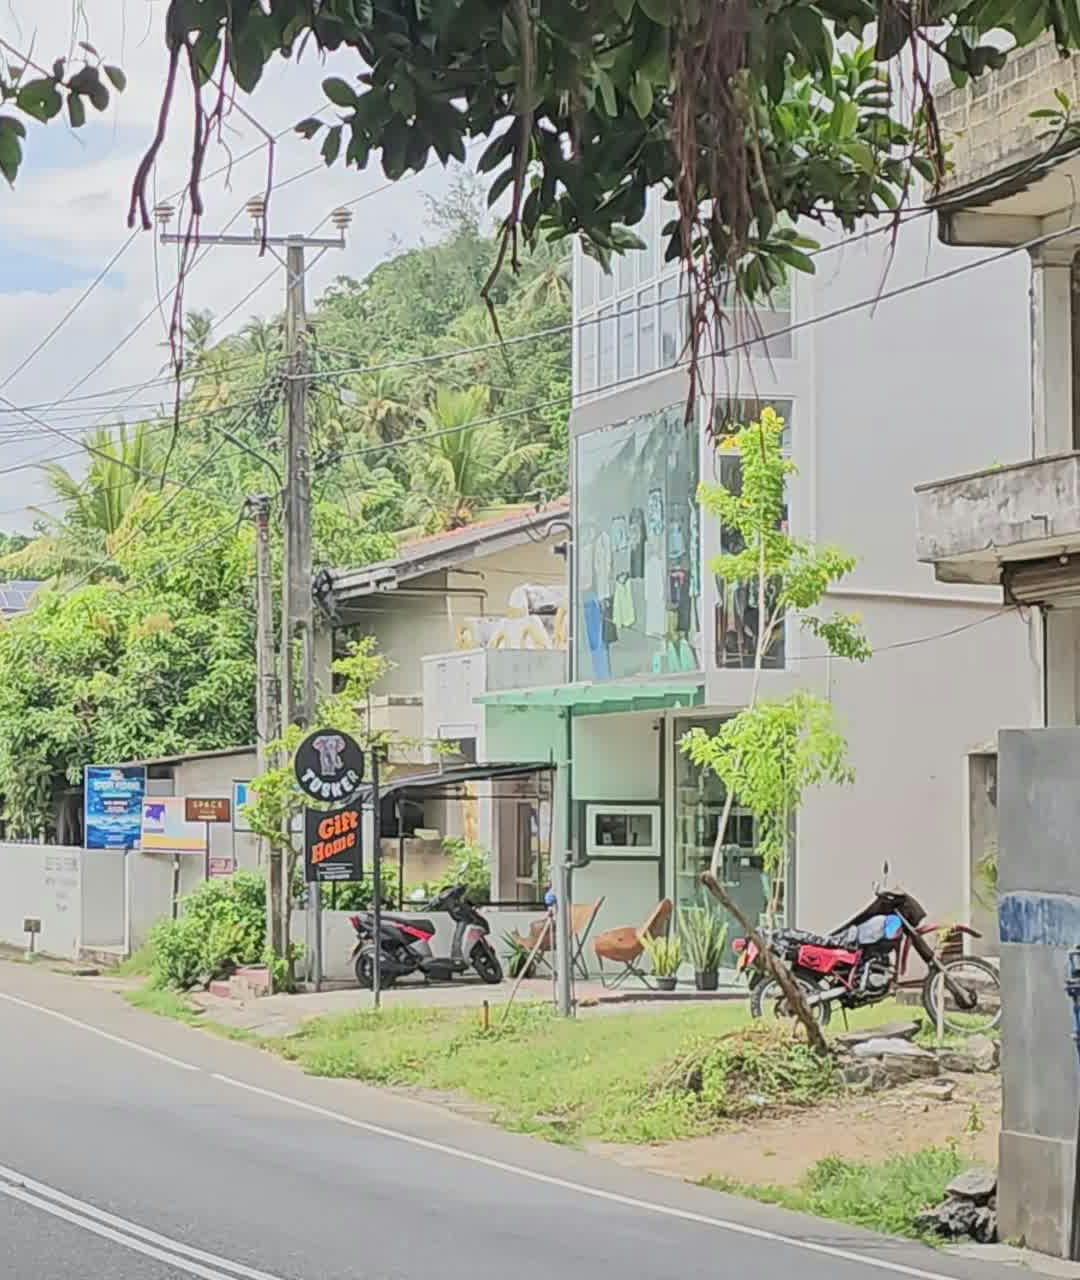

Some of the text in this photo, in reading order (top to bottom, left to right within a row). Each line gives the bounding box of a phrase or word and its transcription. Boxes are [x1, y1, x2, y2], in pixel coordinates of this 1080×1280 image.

[301, 768, 359, 798] TUSKER
[193, 800, 223, 809] SPACE
[318, 810, 359, 840] Gift
[311, 832, 356, 865] Home
